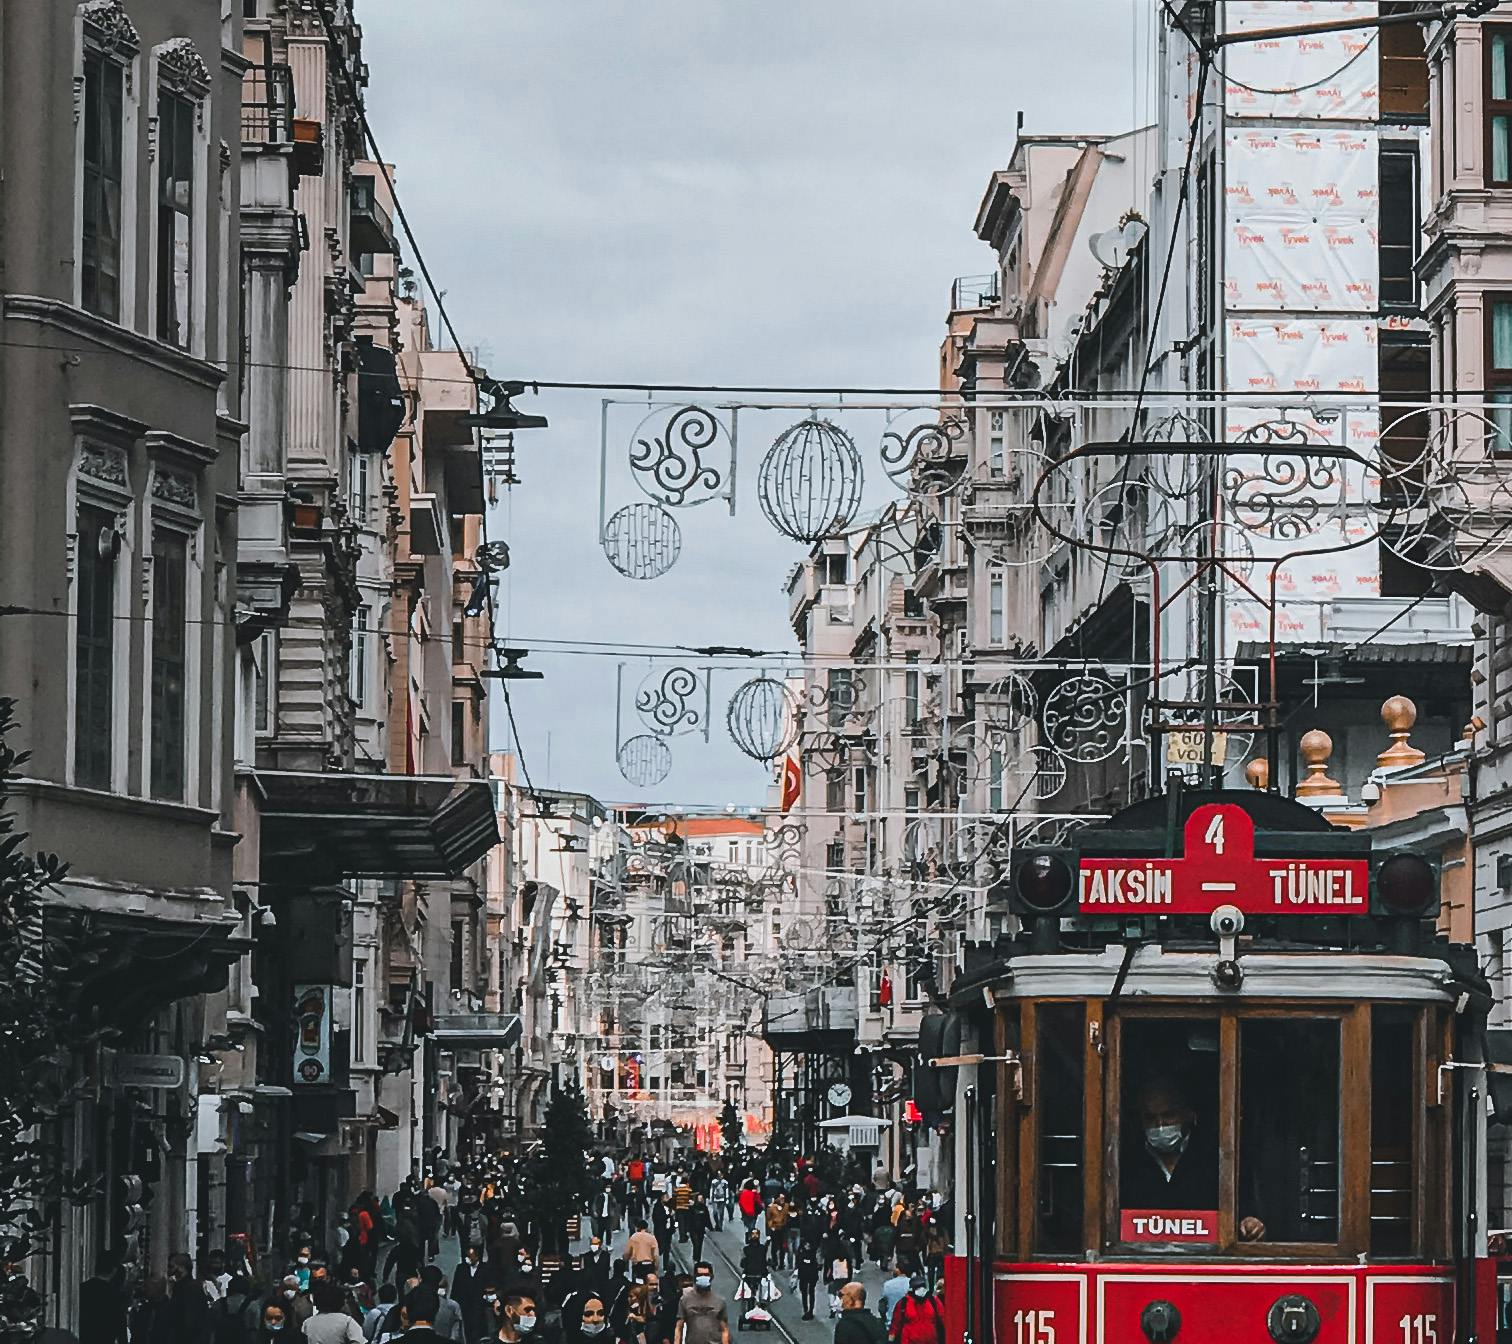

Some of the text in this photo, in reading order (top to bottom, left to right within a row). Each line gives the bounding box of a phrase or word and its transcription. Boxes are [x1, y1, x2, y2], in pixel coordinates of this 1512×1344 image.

[1204, 814, 1225, 854] 4
[1269, 863, 1363, 904] TÜNEL
[1132, 1215, 1209, 1235] TÜNEL
